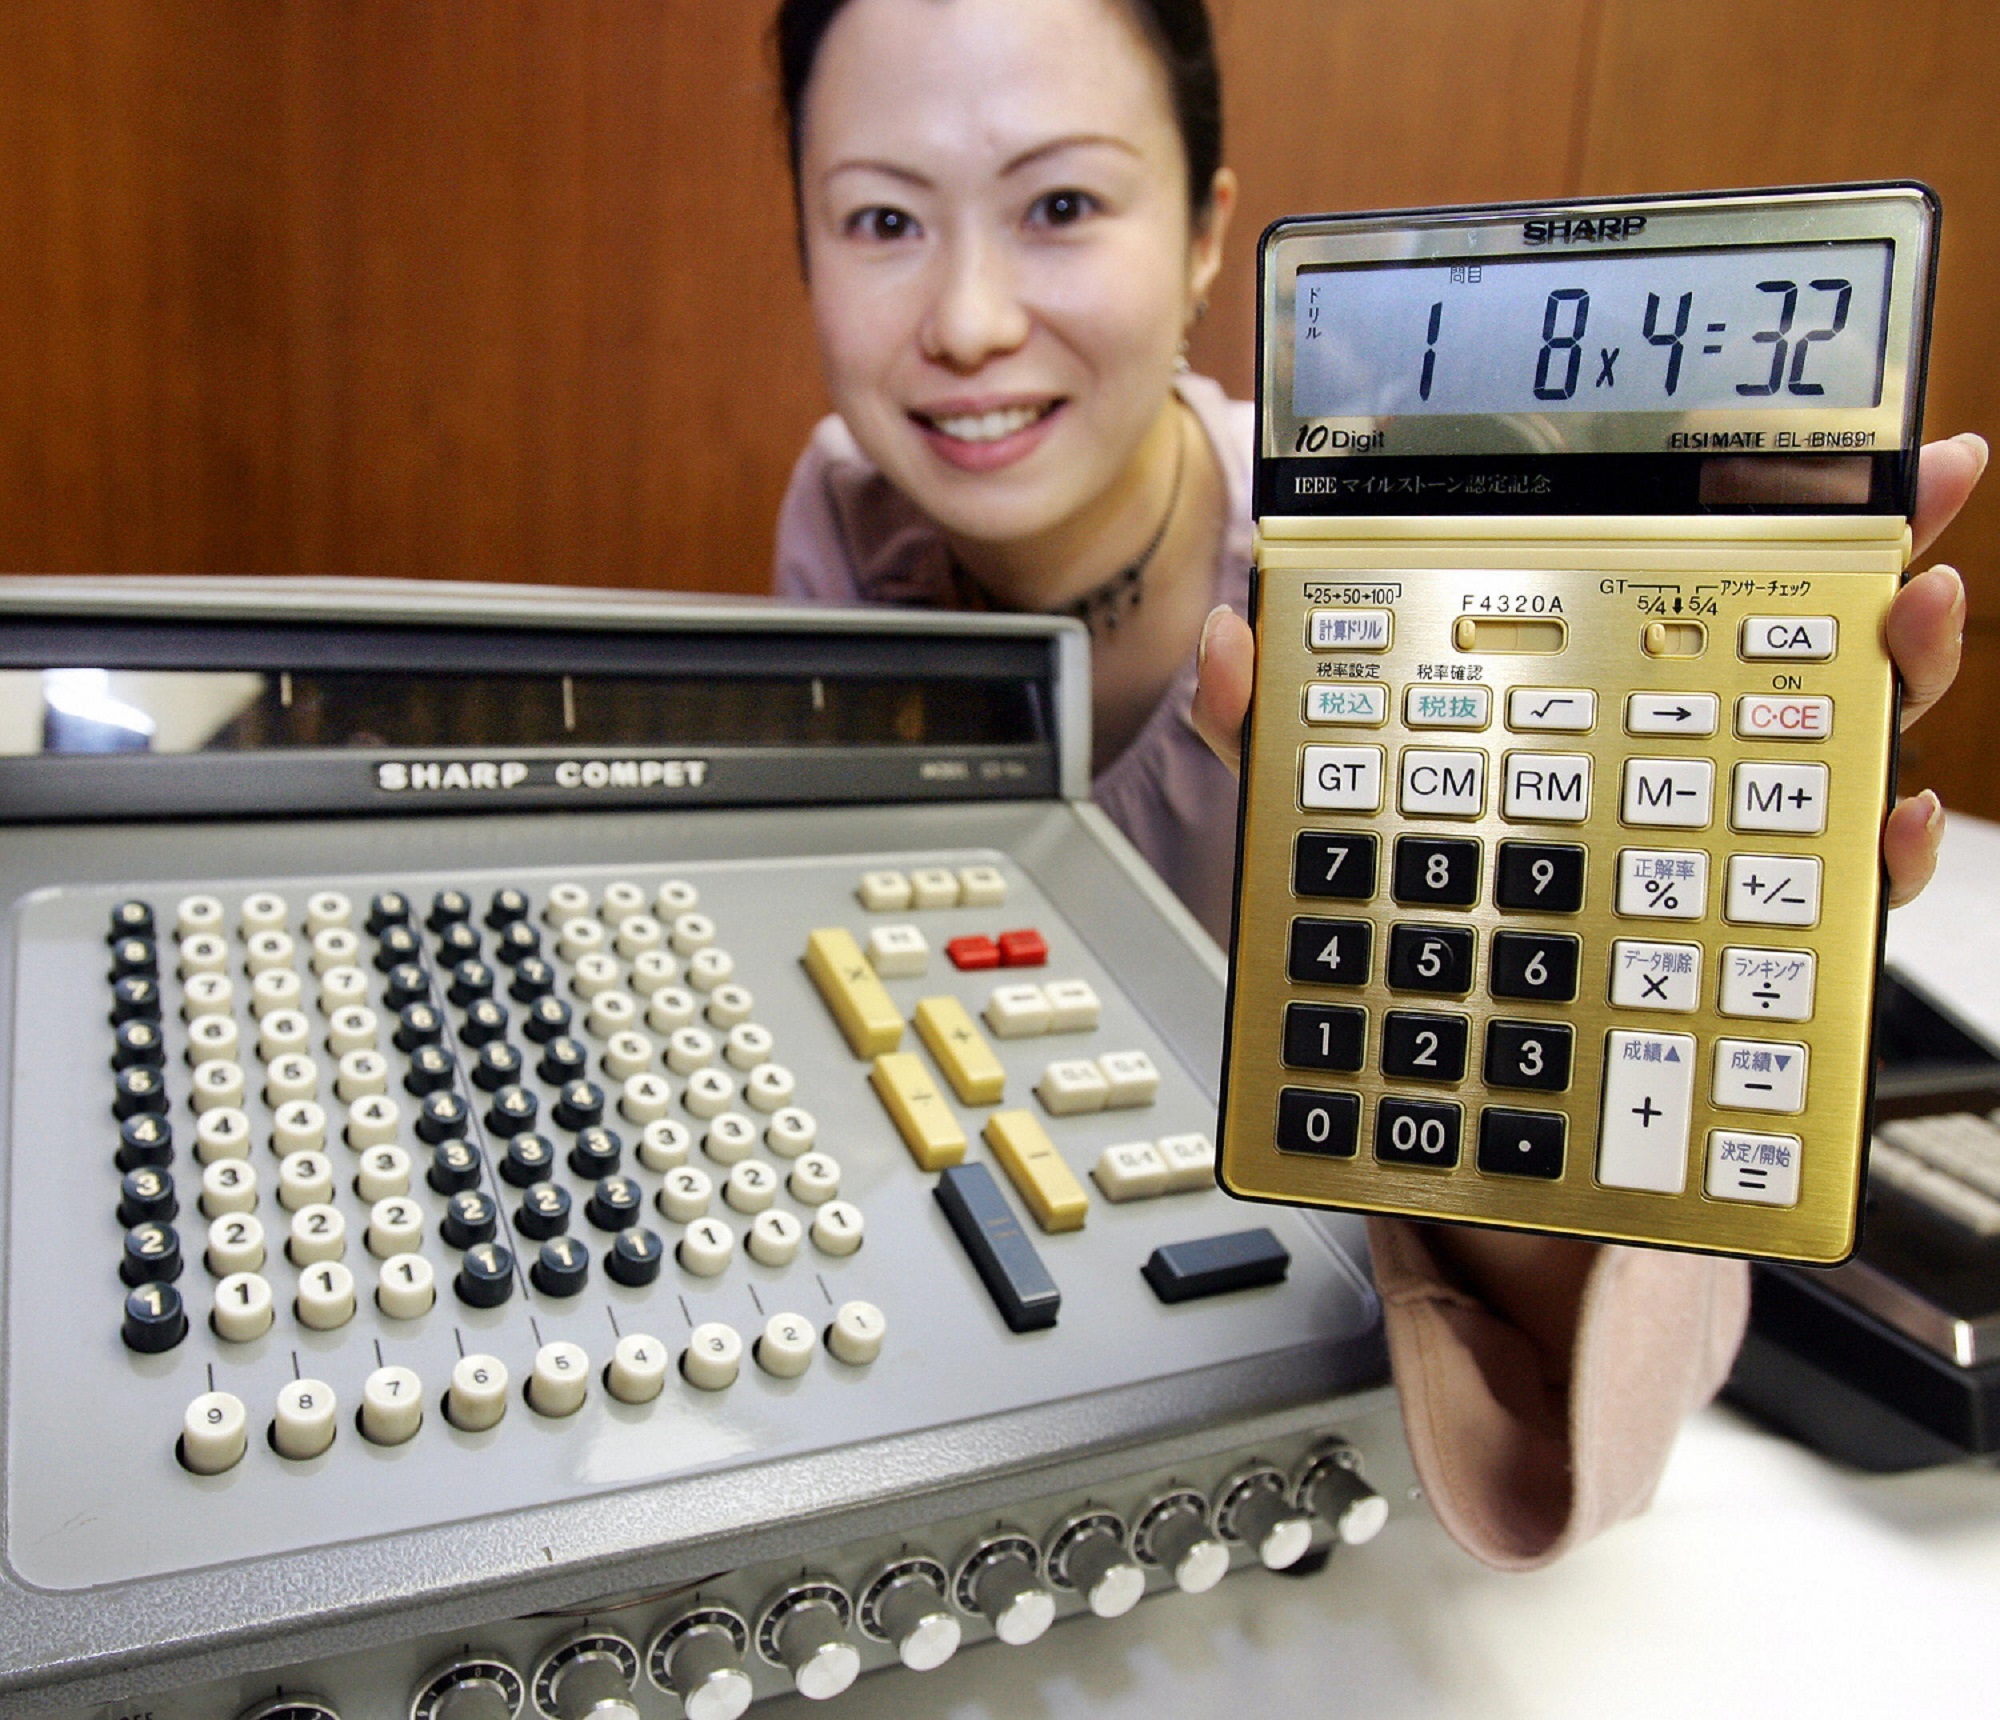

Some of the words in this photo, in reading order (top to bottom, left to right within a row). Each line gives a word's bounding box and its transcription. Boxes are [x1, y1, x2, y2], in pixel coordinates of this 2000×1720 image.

[1523, 216, 1647, 241] SHARP
[1307, 287, 1321, 339] ドリル
[1295, 424, 1328, 452] 10
[1332, 430, 1384, 451] Digit
[1670, 432, 1766, 449] ELSIMATE
[1776, 431, 1876, 448] EL-BN691
[1294, 476, 1337, 494] IEEE
[1342, 474, 1551, 494] マイルストーン認定記念
[1599, 579, 1628, 594] GT
[1720, 579, 1811, 597] アンサーチェック
[1314, 588, 1332, 604] 25
[1344, 589, 1360, 604] 50
[1372, 588, 1394, 605] 100
[1637, 596, 1666, 615] 5/4
[1689, 596, 1718, 615] 5/4
[1319, 618, 1382, 641] 計算ドリル
[1767, 625, 1812, 649] CA
[1317, 662, 1381, 679] 税率設定
[1417, 664, 1483, 681] 税率確認
[1772, 675, 1802, 690] ON
[1318, 692, 1373, 714] 税込
[1418, 695, 1477, 718] 税抜
[378, 761, 529, 791] SHARP
[555, 760, 707, 789] COMPET
[1317, 765, 1366, 792] GT
[1410, 766, 1475, 797] CM
[1515, 772, 1582, 802] RM
[1747, 782, 1813, 814] M+
[1326, 848, 1348, 881] 7
[1426, 854, 1449, 889] 8
[1633, 859, 1695, 880] 正解率
[1532, 860, 1555, 896] 9
[1645, 880, 1678, 909] %
[1317, 936, 1342, 970] 4
[1418, 943, 1441, 977] 5
[1624, 950, 1692, 973] データ削除
[1525, 950, 1548, 985] 6
[1735, 957, 1805, 981] ランキング
[1318, 1022, 1330, 1055] 1
[1413, 1032, 1437, 1065] 2
[1520, 1040, 1544, 1076] 3
[703, 1078, 720, 1093] 4
[763, 1072, 780, 1086] 4
[570, 1087, 592, 1106] 4
[639, 1083, 655, 1097] 4
[366, 1104, 383, 1118] 4
[434, 1096, 456, 1116] 4
[504, 1092, 527, 1112] 4
[212, 1117, 232, 1133] 4
[289, 1110, 308, 1126] 4
[784, 1116, 803, 1132] 3
[1306, 1108, 1329, 1143] 0
[135, 1119, 158, 1141] 4
[659, 1129, 676, 1145] 3
[725, 1122, 742, 1137] 3
[1392, 1116, 1446, 1153] 00
[521, 1138, 543, 1159] 3
[590, 1132, 611, 1151] 3
[376, 1153, 395, 1169] 3
[448, 1147, 469, 1165] 3
[1721, 1140, 1791, 1167] 決定/開始
[220, 1168, 239, 1185] 3
[296, 1160, 316, 1177] 3
[745, 1169, 765, 1186] 2
[808, 1163, 828, 1178] 2
[136, 1174, 160, 1196] 3
[608, 1182, 630, 1202] 2
[679, 1176, 698, 1192] 2
[461, 1199, 484, 1219] 2
[536, 1190, 560, 1211] 2
[308, 1215, 328, 1233] 2
[386, 1207, 407, 1224] 2
[832, 1211, 847, 1227] 1
[227, 1224, 245, 1243] 2
[701, 1228, 717, 1245] 1
[769, 1221, 784, 1236] 1
[140, 1230, 164, 1253] 2
[631, 1237, 649, 1256] 1
[481, 1253, 498, 1272] 1
[557, 1246, 574, 1266] 1
[317, 1271, 333, 1292] 1
[398, 1264, 413, 1283] 1
[235, 1282, 249, 1304] 1
[144, 1290, 161, 1316] 1
[856, 1315, 867, 1329] 1
[784, 1327, 798, 1341] 2
[710, 1338, 724, 1352] 3
[557, 1356, 569, 1369] 5
[634, 1348, 648, 1362] 4
[475, 1369, 488, 1383] 6
[386, 1381, 400, 1396] 7
[299, 1395, 313, 1408] 8
[206, 1408, 222, 1424] 9
